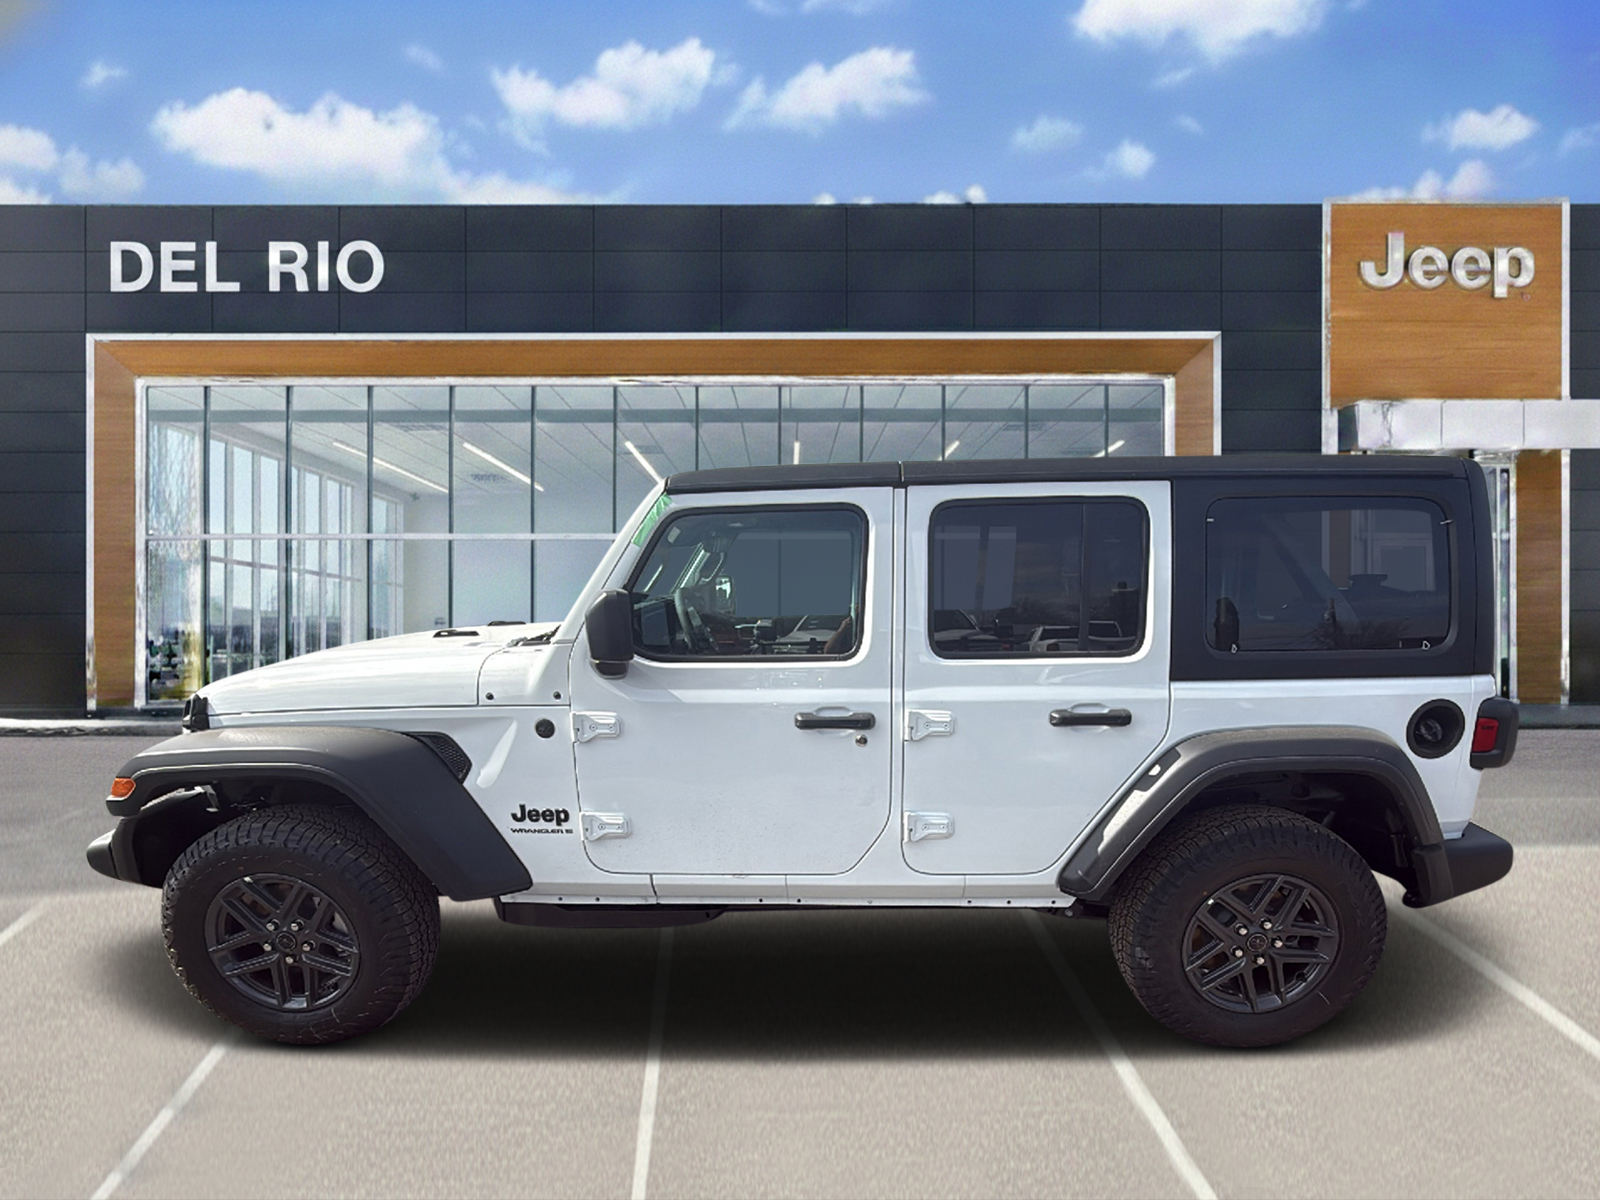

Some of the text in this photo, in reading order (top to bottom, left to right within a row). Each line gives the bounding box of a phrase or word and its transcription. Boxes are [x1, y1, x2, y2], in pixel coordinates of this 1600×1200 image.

[110, 240, 384, 293] DEL RIO
[1360, 232, 1535, 298] Jeep
[511, 803, 570, 826] Jeep
